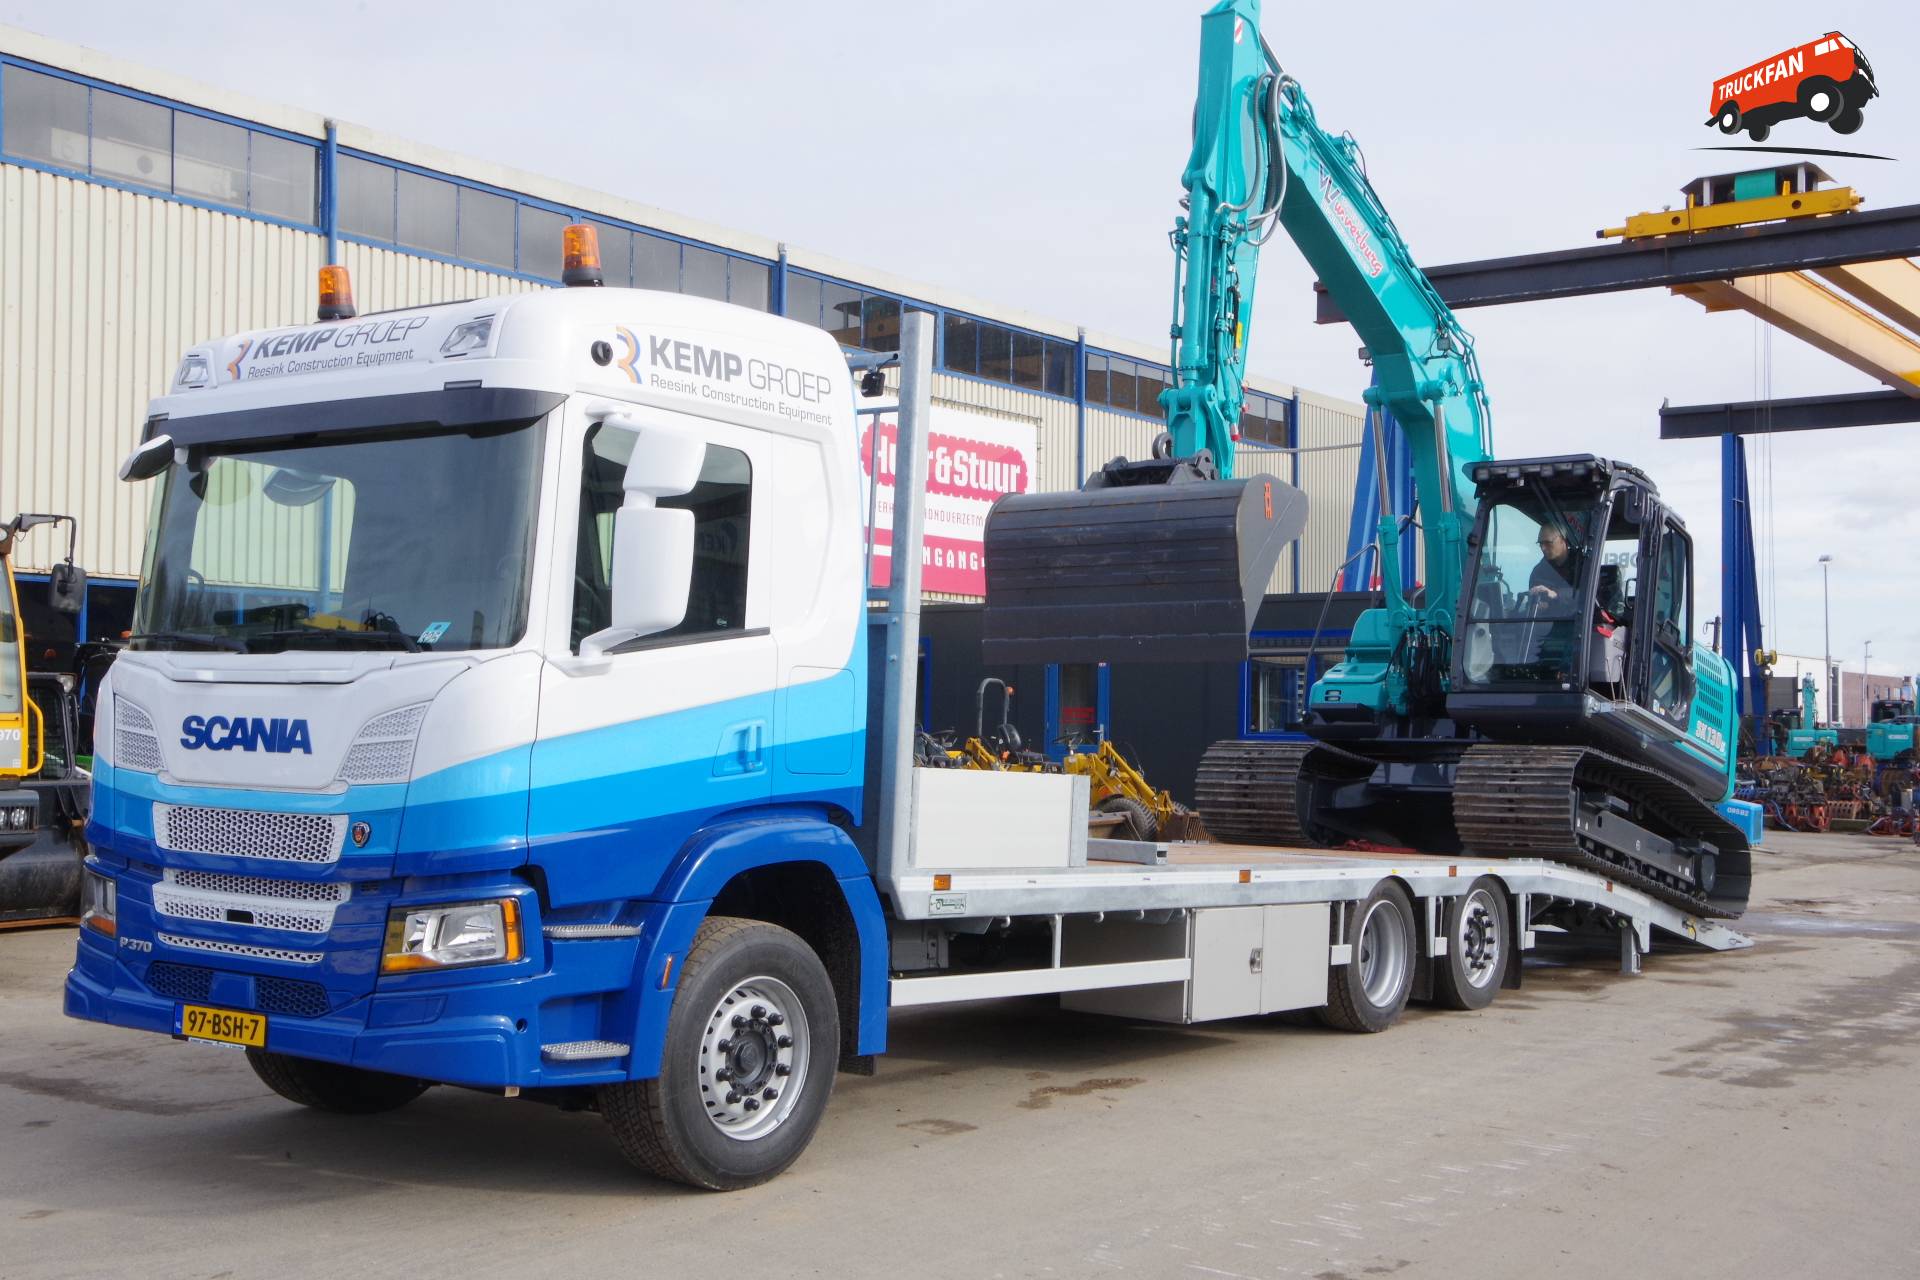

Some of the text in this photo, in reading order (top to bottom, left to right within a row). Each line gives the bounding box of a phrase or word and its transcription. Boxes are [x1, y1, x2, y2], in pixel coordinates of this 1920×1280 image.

[253, 328, 339, 360] KEMP
[334, 316, 430, 349] GROEP
[248, 349, 414, 379] Reesink Construction Equipment
[649, 335, 743, 383] KEMP
[748, 358, 832, 404] GROEP
[650, 373, 833, 426] Reesink Construction Equipment
[922, 545, 979, 571] NGANG
[180, 715, 312, 755] SCANIA
[187, 1009, 259, 1041] 97-BSH-7
